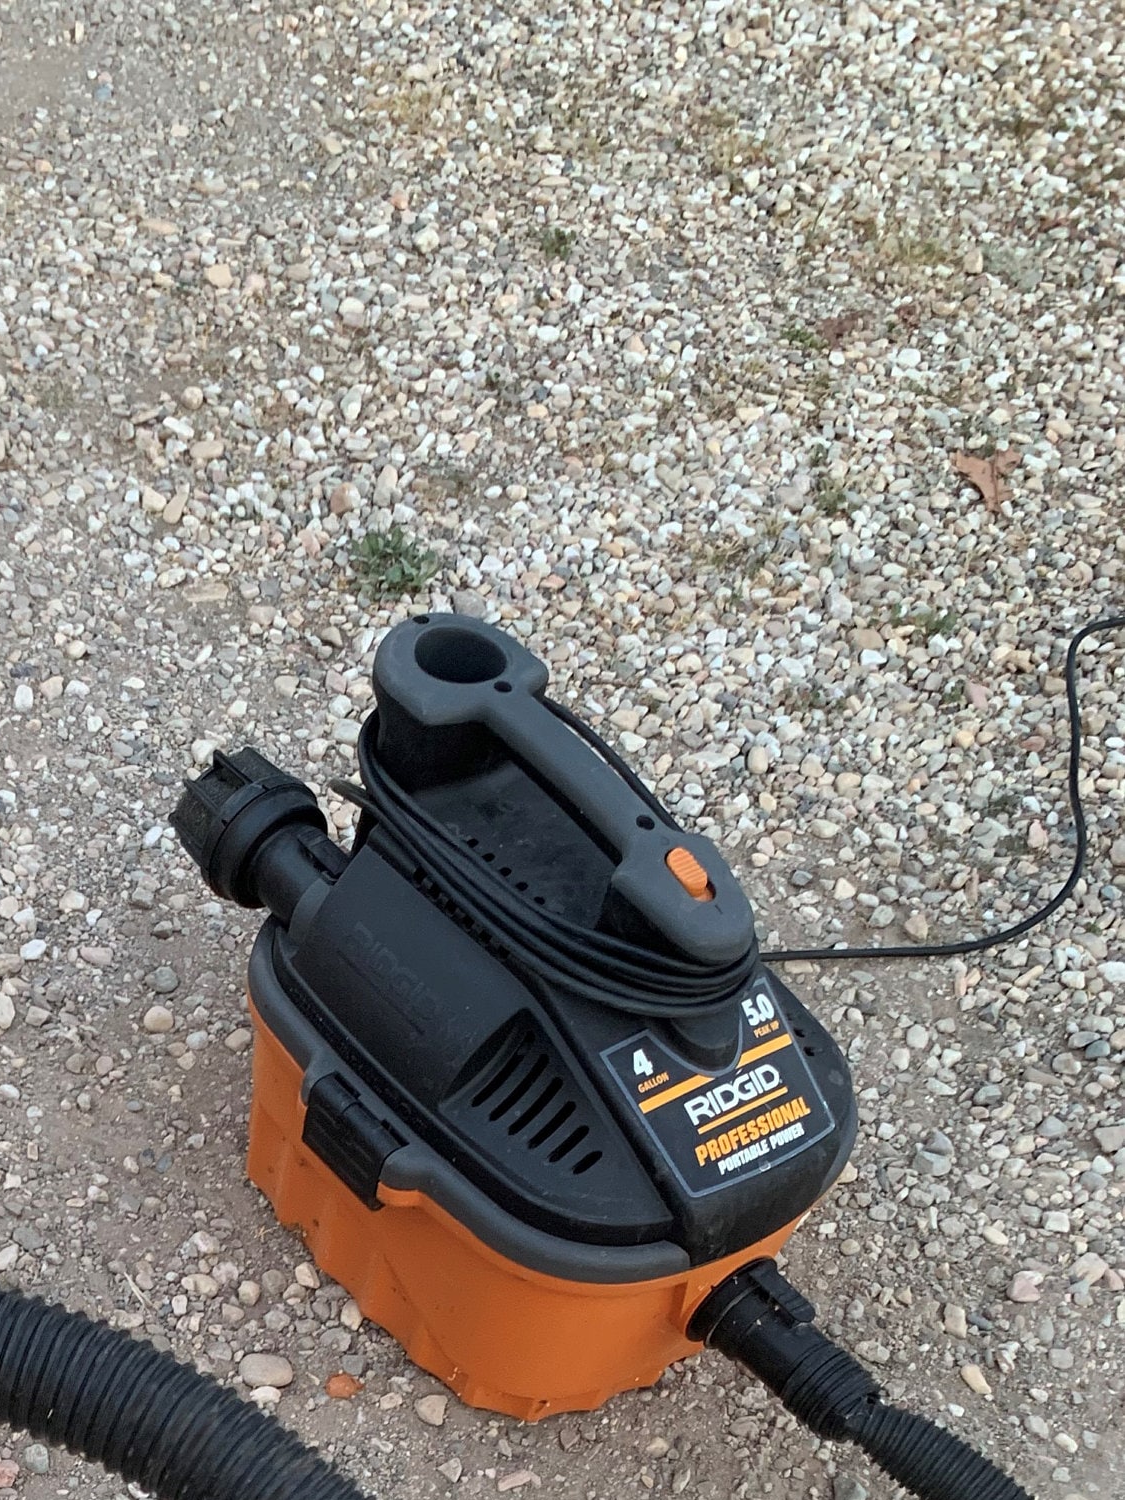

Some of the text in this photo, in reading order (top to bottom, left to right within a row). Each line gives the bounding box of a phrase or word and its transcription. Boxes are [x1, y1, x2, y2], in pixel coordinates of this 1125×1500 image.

[741, 993, 775, 1027] 5.0
[753, 1023, 772, 1039] PEAK
[632, 1048, 653, 1077] 4
[638, 1072, 669, 1093] GALLON
[683, 1063, 781, 1126] RIDGID
[694, 1096, 811, 1167] PROFESSIONAL
[717, 1122, 805, 1175] PORTABLE POWER
